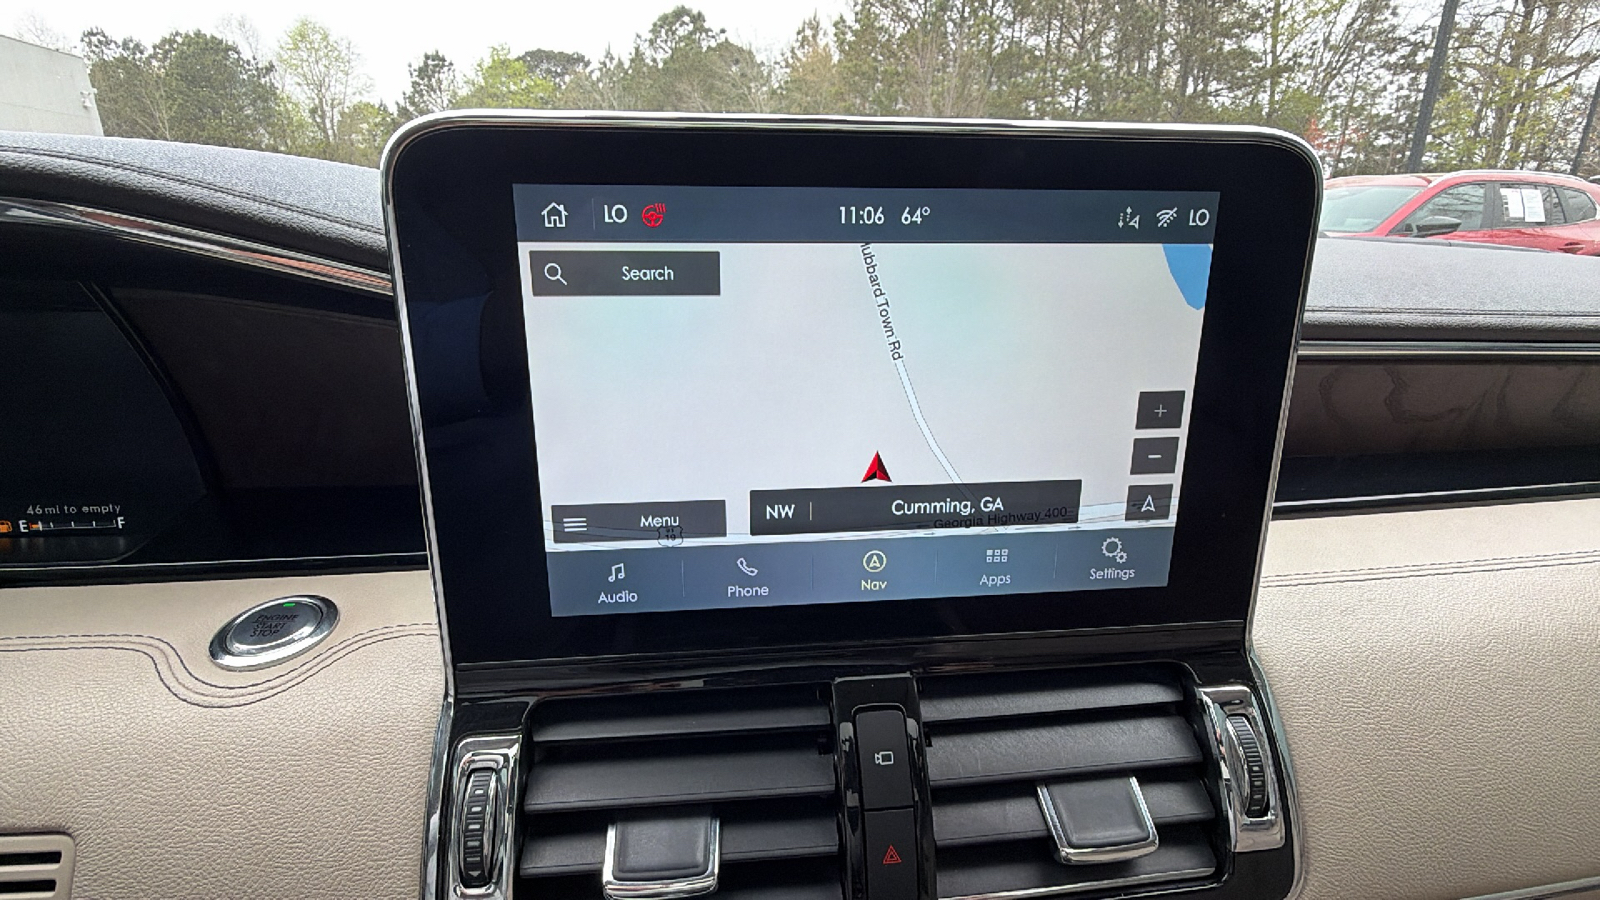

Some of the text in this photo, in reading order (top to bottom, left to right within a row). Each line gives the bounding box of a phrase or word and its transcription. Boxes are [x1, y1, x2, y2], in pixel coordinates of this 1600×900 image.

[603, 203, 628, 224] LO
[838, 206, 885, 226] 11:06
[900, 206, 931, 226] 64°
[1188, 208, 1210, 226] LO
[621, 265, 674, 282] Search
[877, 298, 895, 338] Town
[888, 339, 904, 361] Rd
[26, 505, 43, 515] 46
[64, 505, 77, 514] to
[82, 504, 121, 514] empty
[765, 504, 796, 521] NW
[891, 496, 1004, 516] Cumming, GA
[117, 516, 126, 529] F
[640, 514, 680, 528] Menu
[933, 506, 1068, 529] Georgia Highway 400
[18, 520, 29, 533] E
[979, 572, 1012, 587] Apps
[1089, 566, 1136, 581] Settings
[727, 584, 769, 598] Phone
[860, 579, 888, 591] Nav
[597, 589, 639, 604] Audio
[255, 614, 299, 623] ENGINE
[249, 629, 280, 638] STOP
